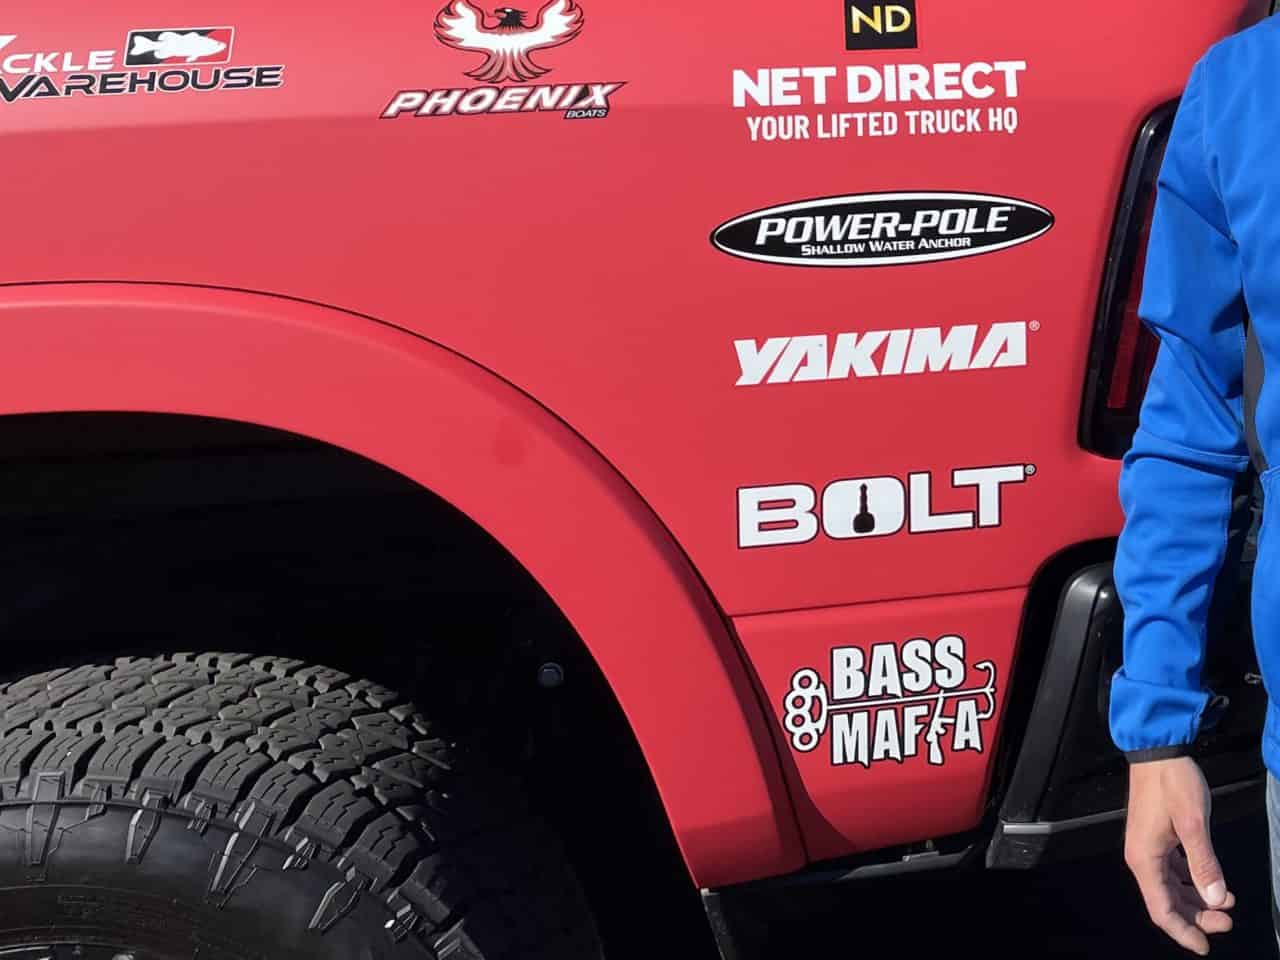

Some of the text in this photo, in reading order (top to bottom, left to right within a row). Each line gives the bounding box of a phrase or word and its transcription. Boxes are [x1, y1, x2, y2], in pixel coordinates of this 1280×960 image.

[851, 5, 911, 34] ND
[0, 35, 117, 74] CKLE
[380, 81, 627, 119] PHOENIX
[732, 61, 1026, 107] NET DIRECT
[563, 108, 608, 120] BOATS
[747, 107, 1018, 141] YOUR LIFTED TRUCK HQ
[755, 206, 1012, 246] POWER-POLE
[800, 236, 972, 257] SHALLOW WATER ANCHOR
[733, 321, 1027, 386] YAKIMA
[736, 464, 1025, 550] BOLT
[830, 635, 967, 700] BASS
